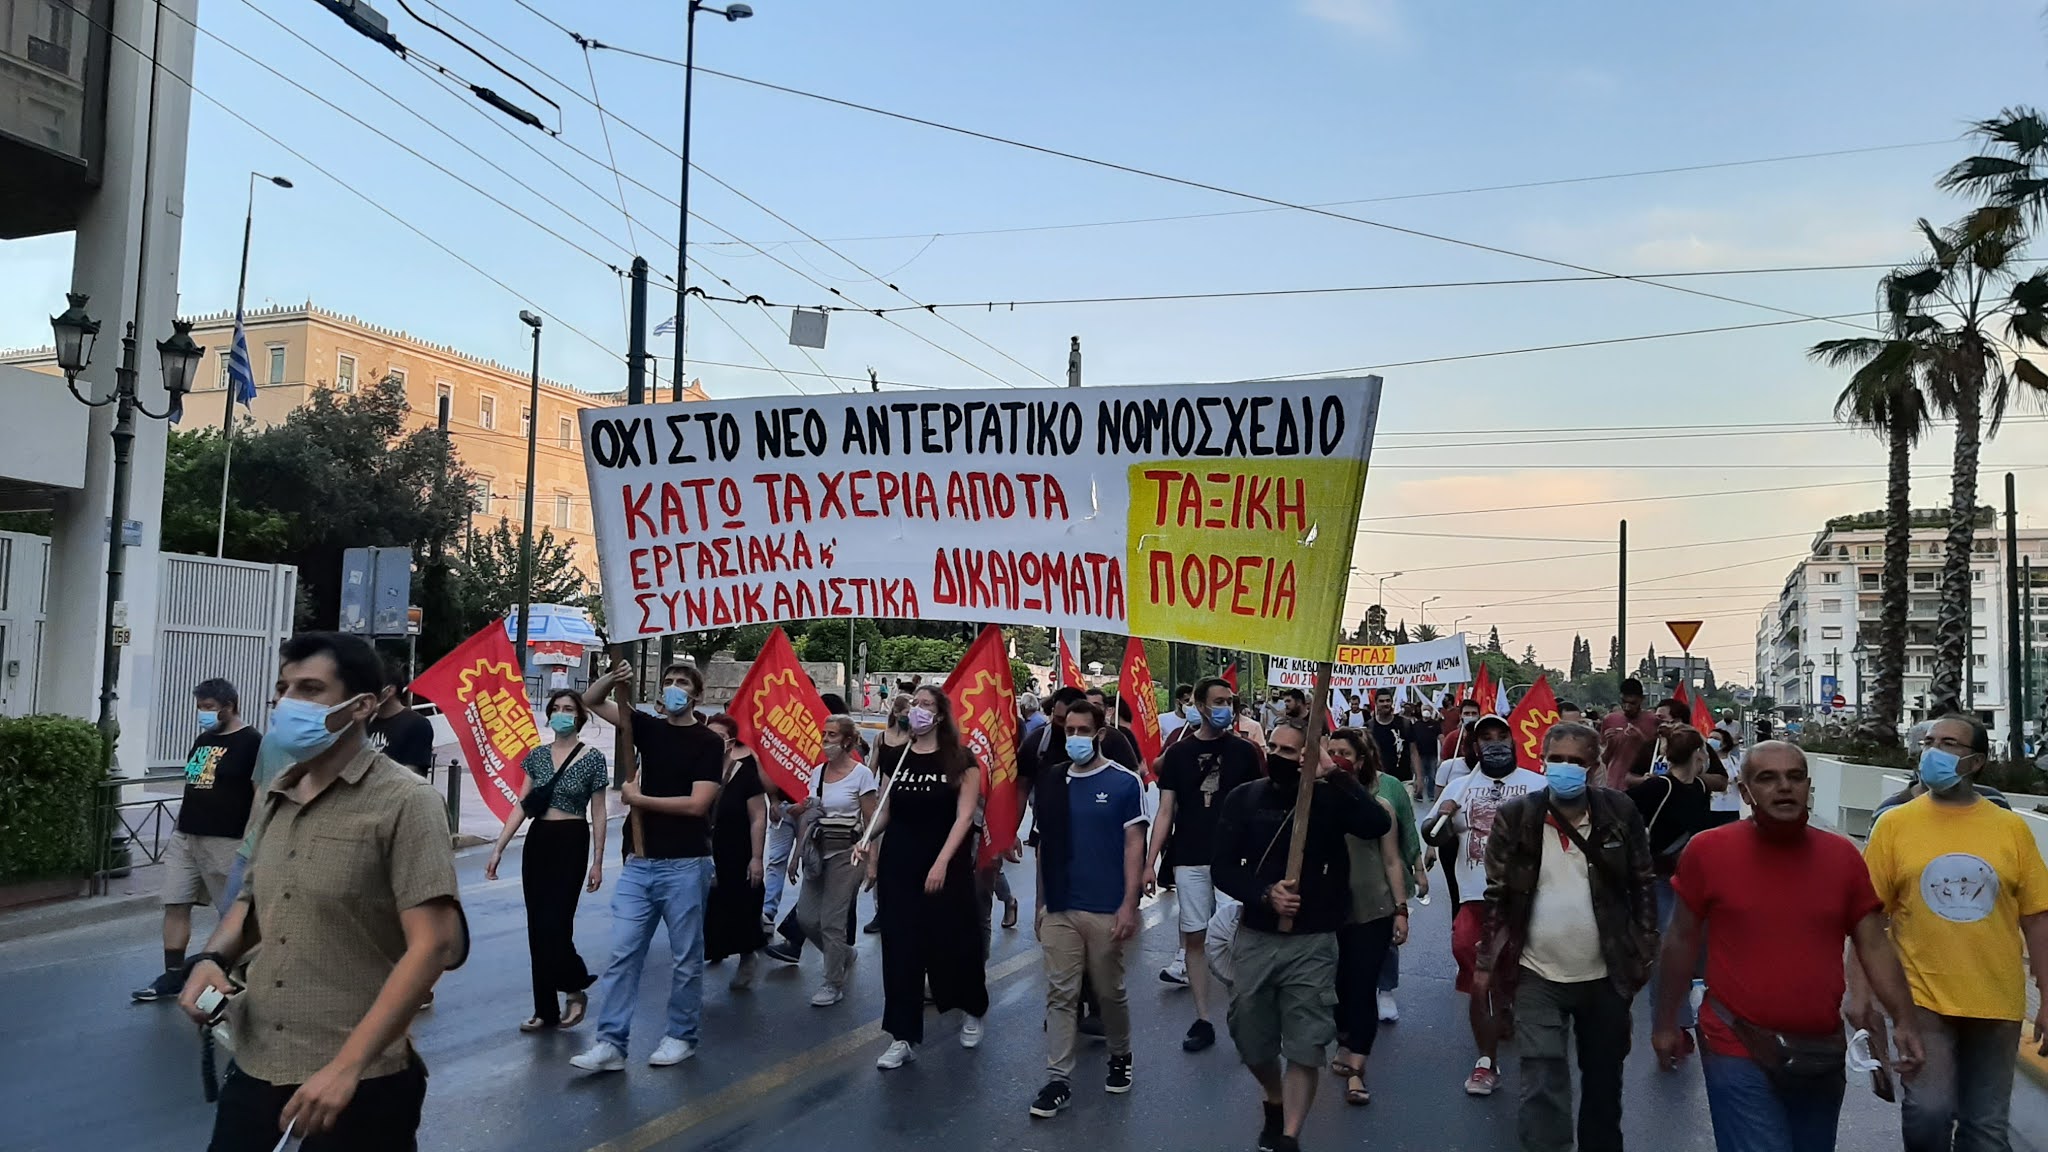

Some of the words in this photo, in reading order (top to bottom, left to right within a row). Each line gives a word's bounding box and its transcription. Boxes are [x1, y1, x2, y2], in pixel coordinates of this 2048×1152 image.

[591, 418, 657, 469] ΟΧΙ
[666, 412, 740, 464] ΣΤΟ
[755, 408, 828, 461] ΝΕΟ
[842, 401, 1083, 456] ΑΝΤΕΡΓΑΤΙΚΟ
[1098, 395, 1346, 458] ΝΟΜΟΣΧΕΔΙΟ
[753, 473, 812, 525] ΤΑ
[818, 469, 940, 521] ΧΕΡΙΑ
[947, 471, 1016, 521] ΑΠΟ
[1016, 473, 1069, 520] ΤΑ
[1144, 470, 1306, 531] ΤΑΞΙΚΗ
[630, 531, 813, 590] ΕΡΓΑΣΙΑΚΑ
[1149, 551, 1297, 622] ΠΟΡΕΙΑ
[634, 578, 920, 634] ΣΥΝΔΙΚΑΛΙΣΤΙΚΑ
[934, 548, 1126, 621] ΔΙΚΑΙΩΜΑΤΑ
[1271, 656, 1288, 670] ΜΑΣ
[1280, 672, 1300, 685] ΟΛΟΙ
[464, 708, 475, 724] ΤΟ
[482, 757, 498, 777] ΤΟΥ
[476, 689, 526, 760] ΠΟΡΕΙΑ
[760, 735, 771, 749] ΤΟ
[769, 747, 794, 771] ΔΙΚΙΟ
[762, 726, 793, 757] ΝΟΜΟΣ
[766, 704, 821, 766] ΠΟΡΕΙΑ
[484, 743, 505, 771] ΕΙΝΑΙ
